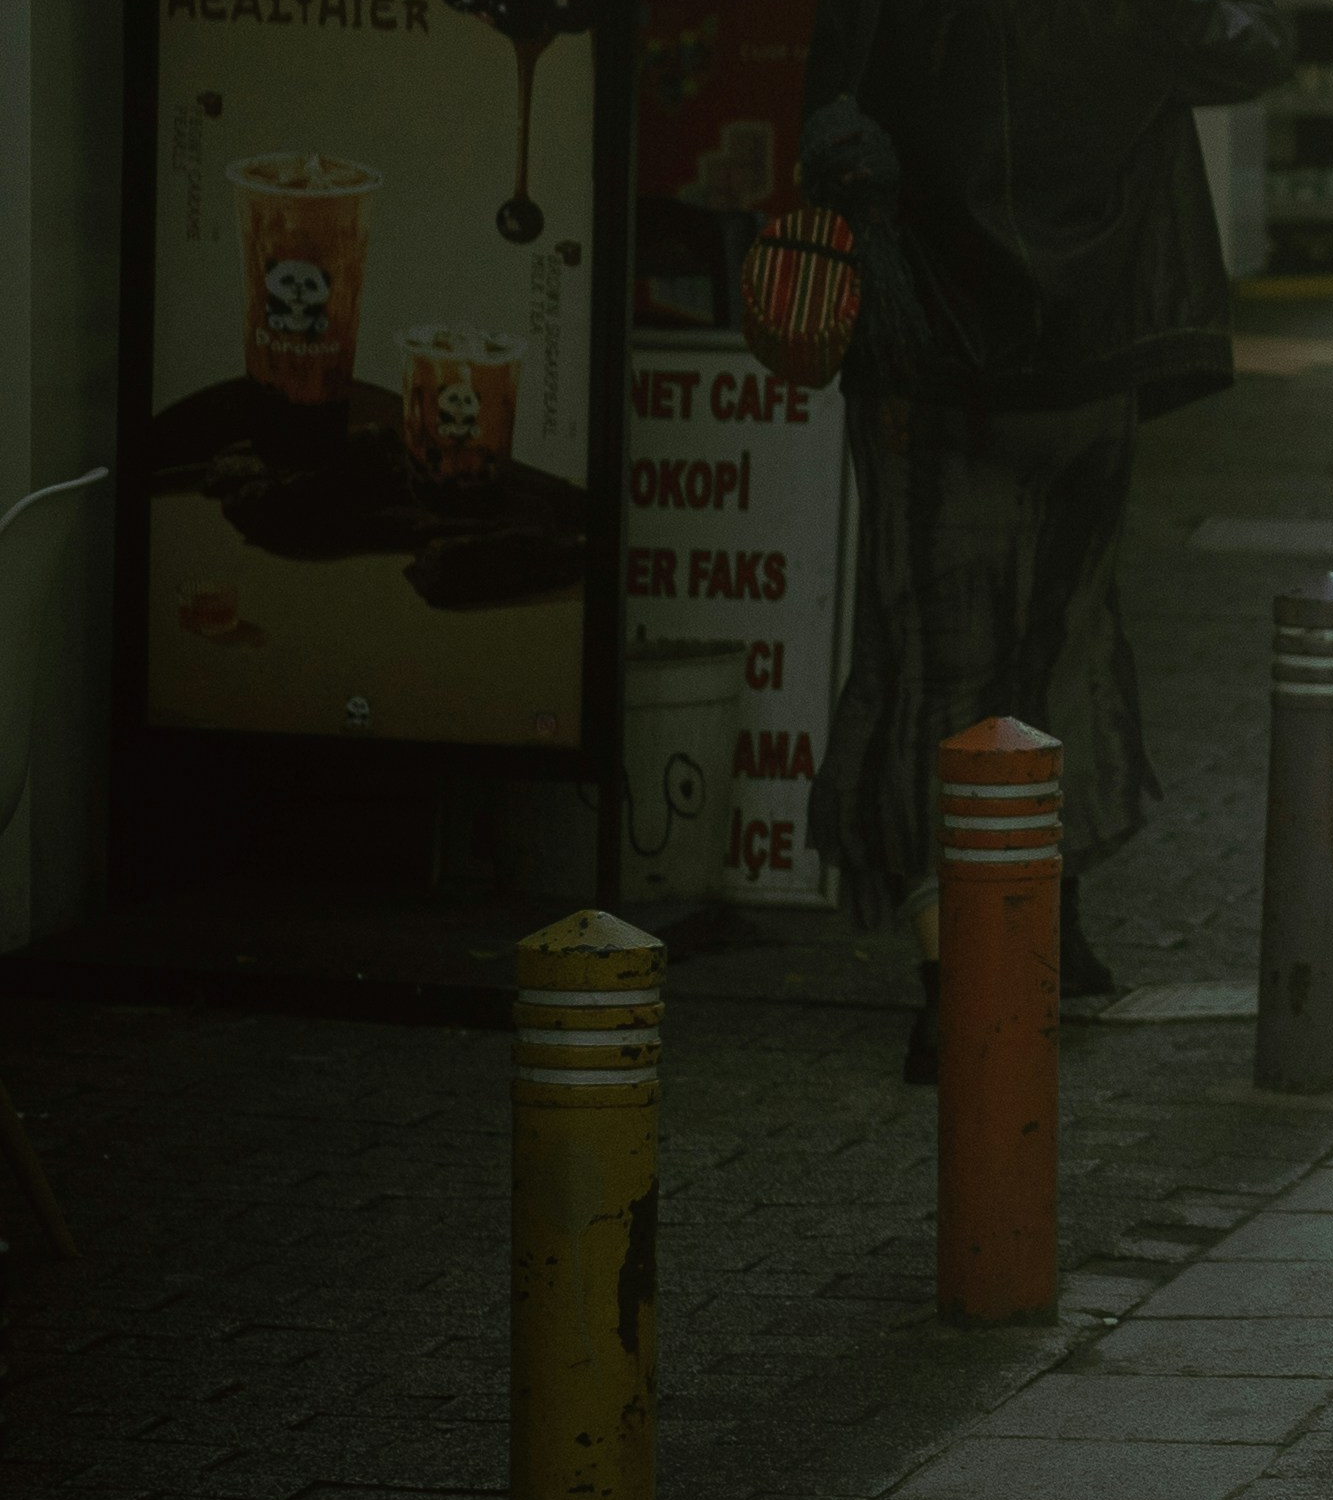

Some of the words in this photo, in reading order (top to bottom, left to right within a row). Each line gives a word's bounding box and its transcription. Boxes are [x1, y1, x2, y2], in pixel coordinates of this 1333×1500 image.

[710, 371, 811, 424] CAFE
[630, 450, 751, 511] OKOPİ
[625, 548, 678, 598] ER
[688, 550, 788, 602] FAKS
[732, 730, 817, 780] AMA
